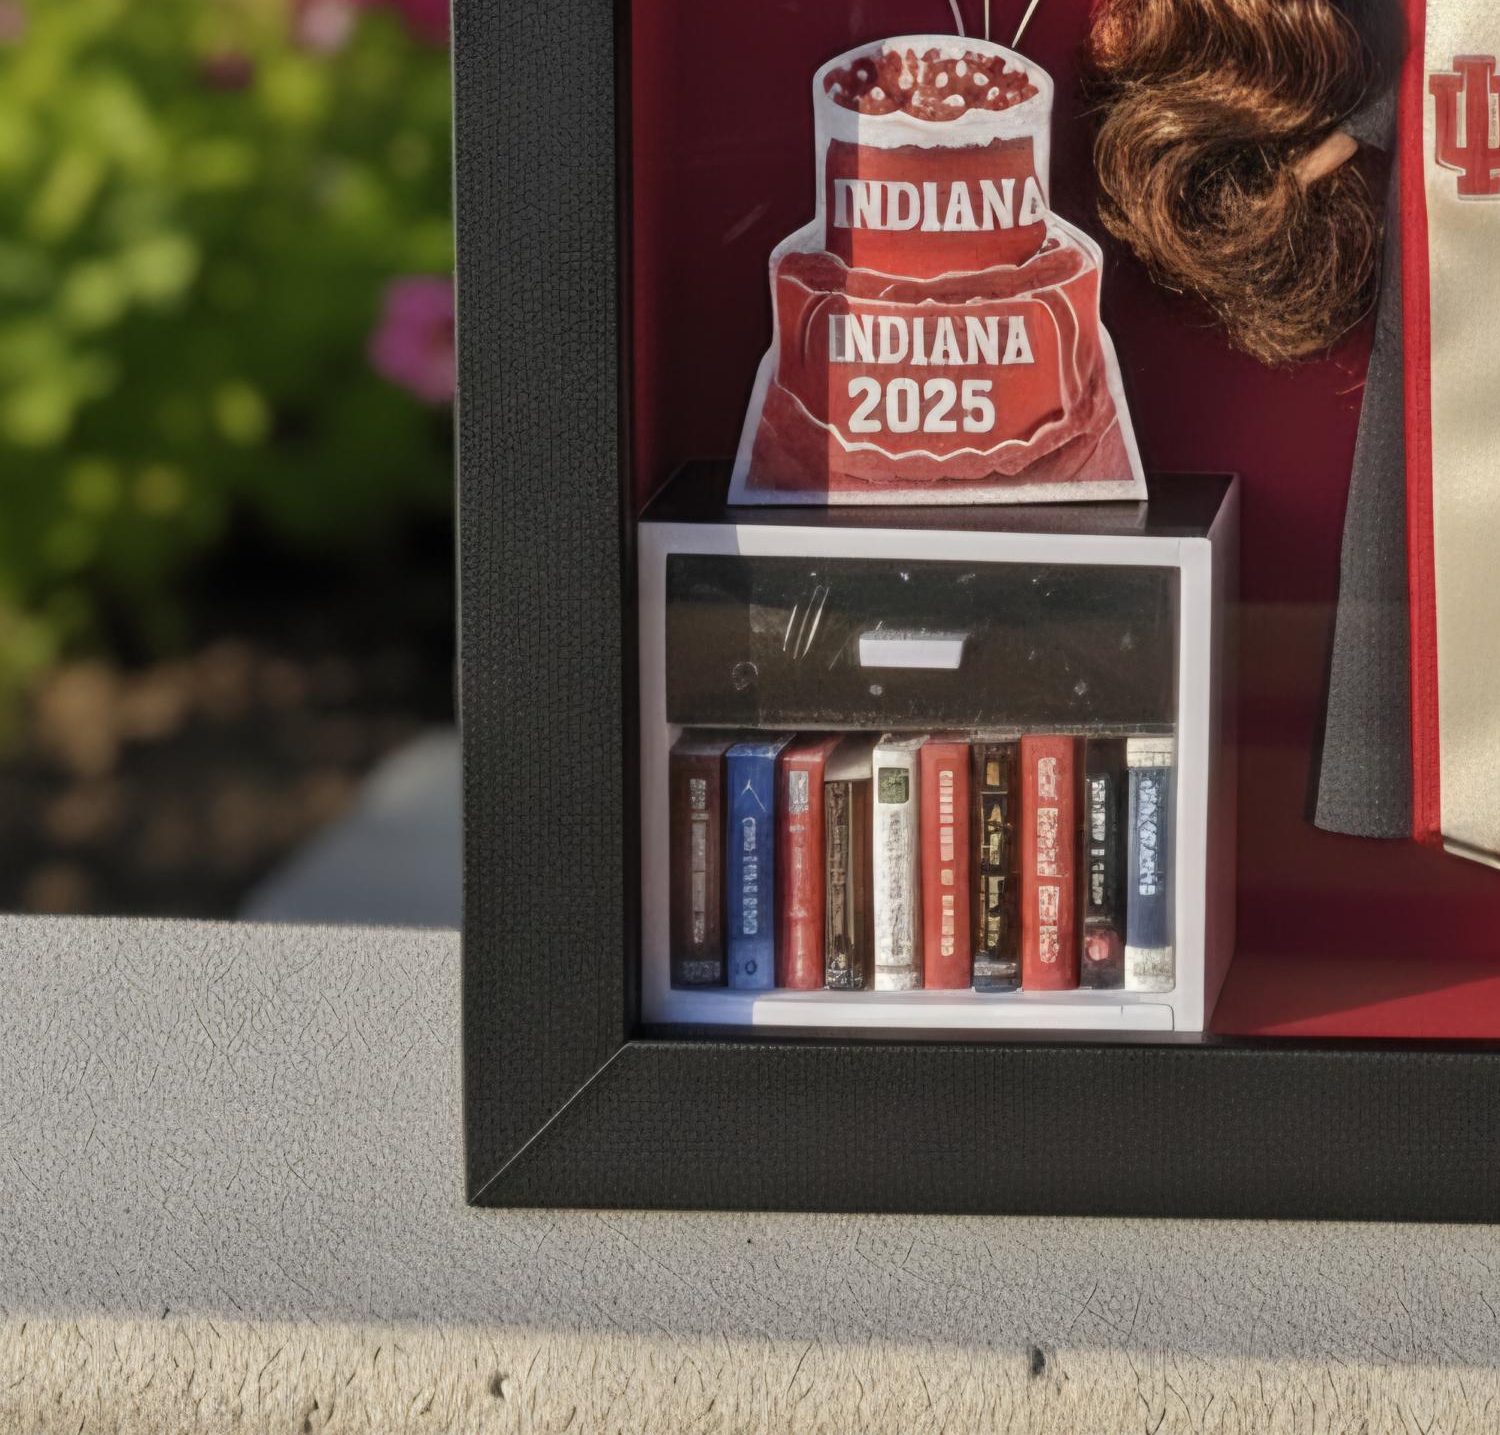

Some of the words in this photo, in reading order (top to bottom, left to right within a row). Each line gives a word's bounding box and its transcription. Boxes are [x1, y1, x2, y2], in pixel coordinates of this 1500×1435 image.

[832, 176, 1046, 232] INDIANA
[828, 313, 1035, 366] INDIANA
[847, 376, 996, 434] 2025
